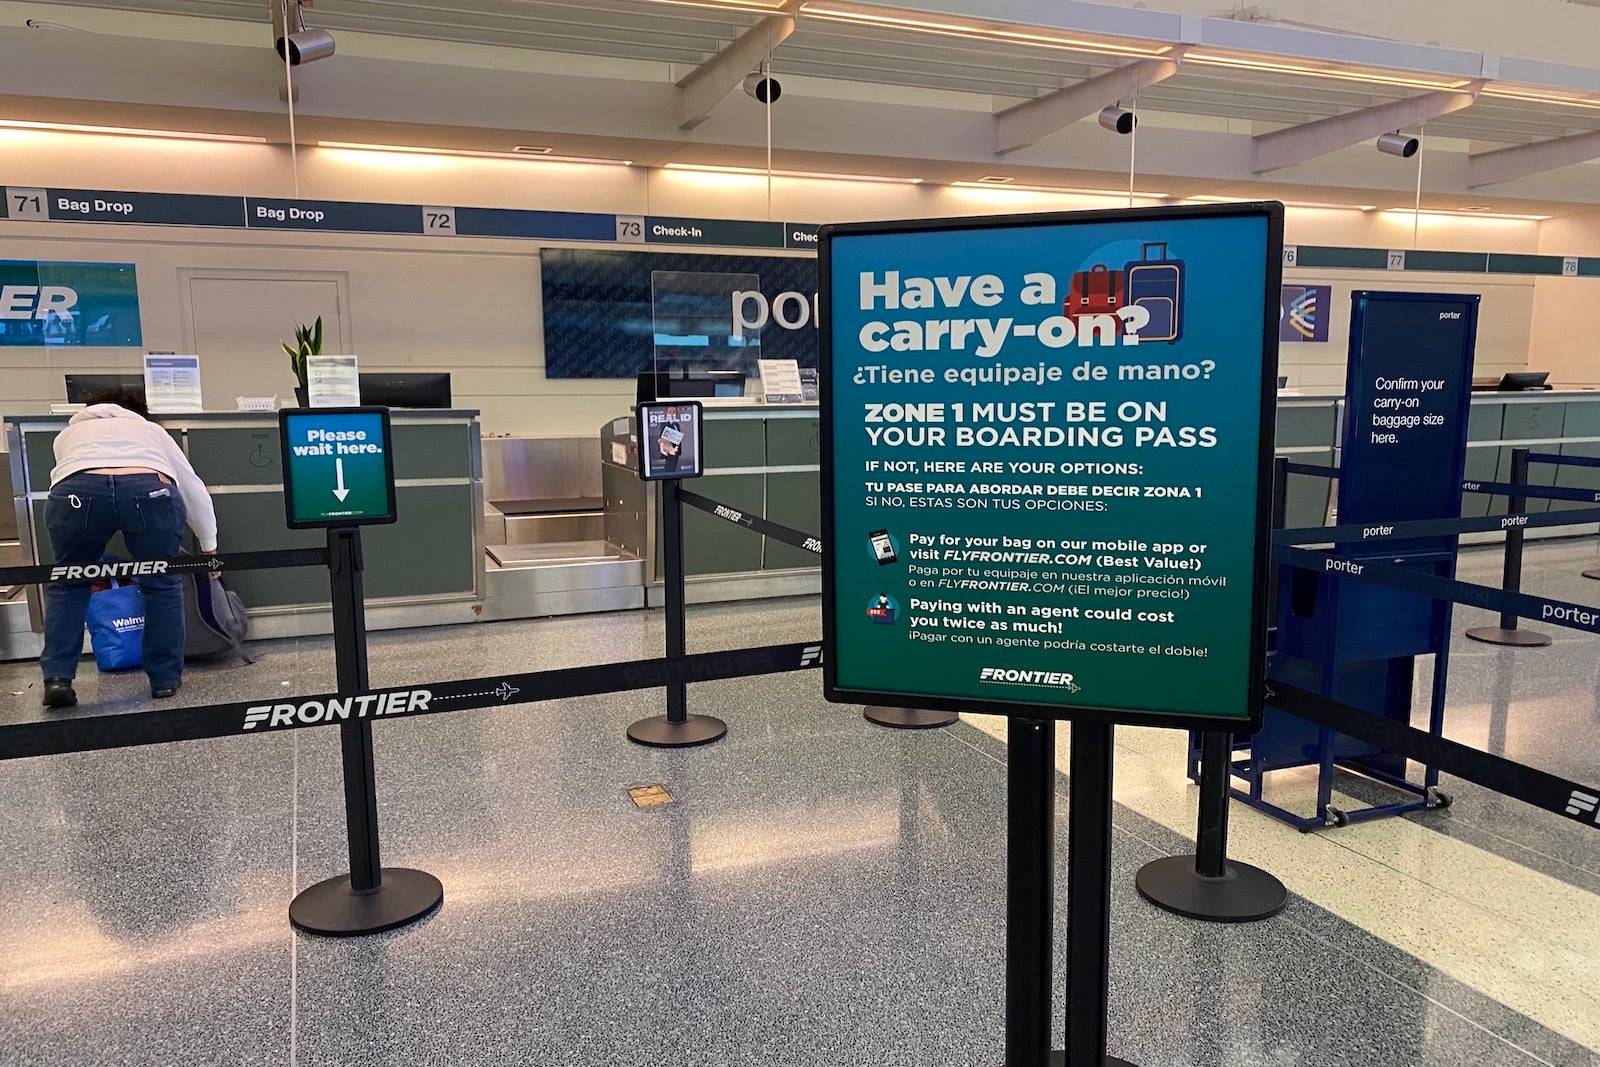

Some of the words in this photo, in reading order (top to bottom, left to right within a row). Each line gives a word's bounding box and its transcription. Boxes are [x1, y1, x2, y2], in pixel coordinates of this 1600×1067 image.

[14, 195, 41, 213] 71
[58, 199, 90, 214] Bag
[94, 200, 134, 215] Drop
[256, 206, 286, 221] Bag
[289, 207, 325, 222] Drop
[426, 212, 451, 229] 72
[620, 221, 641, 237] 73
[652, 225, 702, 238] Check-In
[1390, 254, 1403, 266] 77
[1565, 261, 1577, 272] 78
[859, 270, 1005, 311] Have
[1020, 272, 1056, 306] a
[0, 285, 78, 319] ER
[732, 290, 819, 341] po
[1439, 311, 1461, 321] porter
[858, 304, 1151, 358] carry-on?
[852, 364, 936, 386] ¿Tiene
[943, 361, 1063, 387] equipaje
[1071, 360, 1108, 382] de
[1118, 359, 1216, 381] mano?
[1375, 376, 1419, 391] Confirm
[1421, 379, 1446, 393] your
[864, 403, 945, 423] ZONE
[951, 402, 964, 422] 1
[972, 402, 1056, 423] MUST
[1066, 402, 1107, 422] BE
[1117, 401, 1167, 422] ON
[1373, 397, 1420, 411] carry-on
[649, 414, 679, 424] REAL
[680, 413, 692, 422] ID
[1372, 413, 1421, 429] baggage
[1422, 413, 1445, 426] size
[307, 429, 367, 442] Please
[865, 427, 946, 447] YOUR
[956, 426, 1124, 448] BOARDING
[1135, 426, 1218, 448] PASS
[1371, 431, 1399, 444] here.
[293, 443, 334, 456] wait
[336, 442, 383, 455] here.
[865, 461, 880, 472] IF
[883, 461, 920, 475] NOT,
[923, 461, 966, 473] HERE
[969, 462, 1004, 474] ARE
[1008, 462, 1056, 474] YOUR
[1060, 462, 1144, 475] OPTIONS:
[865, 482, 884, 492] TU
[887, 483, 924, 493] PASE
[926, 484, 966, 494] PARA
[968, 484, 1044, 495] ABORDAR
[1047, 485, 1088, 496] DEBE
[1091, 486, 1140, 497] DECIR
[1143, 487, 1192, 498] ZONA
[1194, 487, 1202, 498] 1
[1462, 482, 1480, 491] rter
[865, 496, 878, 507] SI
[881, 497, 906, 508] NO,
[909, 497, 953, 509] ESTAS
[956, 498, 989, 509] SON
[992, 499, 1021, 510] TUS
[1024, 499, 1109, 512] OPCIONES:
[714, 505, 742, 522] FRONTIER
[1501, 516, 1529, 528] porter
[1363, 525, 1394, 539] porter
[909, 534, 936, 547] Pay
[939, 534, 961, 546] for
[964, 536, 999, 549] your
[1002, 536, 1032, 550] bag
[1036, 540, 1056, 549] on
[1060, 541, 1088, 550] our
[1091, 540, 1148, 552] mobile
[1151, 543, 1185, 555] app
[1188, 544, 1208, 554] or
[909, 549, 940, 560] visit
[943, 550, 1093, 566] FLYFRONTIER.COM
[1096, 555, 1139, 569] (Best
[1143, 556, 1202, 572] Value!)
[1325, 558, 1364, 576] porter
[50, 561, 169, 581] FRONTIER
[908, 565, 939, 577] Paga
[942, 567, 964, 578] por
[967, 567, 980, 577] tu
[983, 569, 1038, 581] equipaje
[1041, 571, 1058, 580] en
[1061, 572, 1111, 583] nuestra
[1114, 574, 1185, 586] aplicación
[1188, 575, 1227, 587] móvil
[908, 579, 917, 588] o
[919, 579, 935, 588] en
[937, 579, 1066, 594] FLYFRONTIER.COM
[1093, 586, 1133, 598] mejor
[1136, 588, 1191, 601] precio!)
[910, 598, 963, 614] Paying
[966, 601, 1002, 614] with
[1006, 605, 1027, 616] an
[1030, 606, 1080, 619] agent
[1083, 608, 1132, 621] could
[1136, 611, 1175, 623] cost
[1542, 603, 1600, 627] porter
[909, 617, 939, 629] you
[942, 616, 986, 630] twice
[990, 621, 1009, 631] as
[1012, 621, 1063, 634] much!
[950, 634, 974, 645] con
[976, 637, 993, 646] un
[996, 638, 1040, 649] agente
[1043, 639, 1086, 651] podría
[1089, 643, 1145, 655] costarte
[1148, 645, 1161, 656] el
[1164, 646, 1208, 658] doble!
[979, 667, 1074, 686] FRONTIER
[243, 689, 432, 731] FRONTIER
